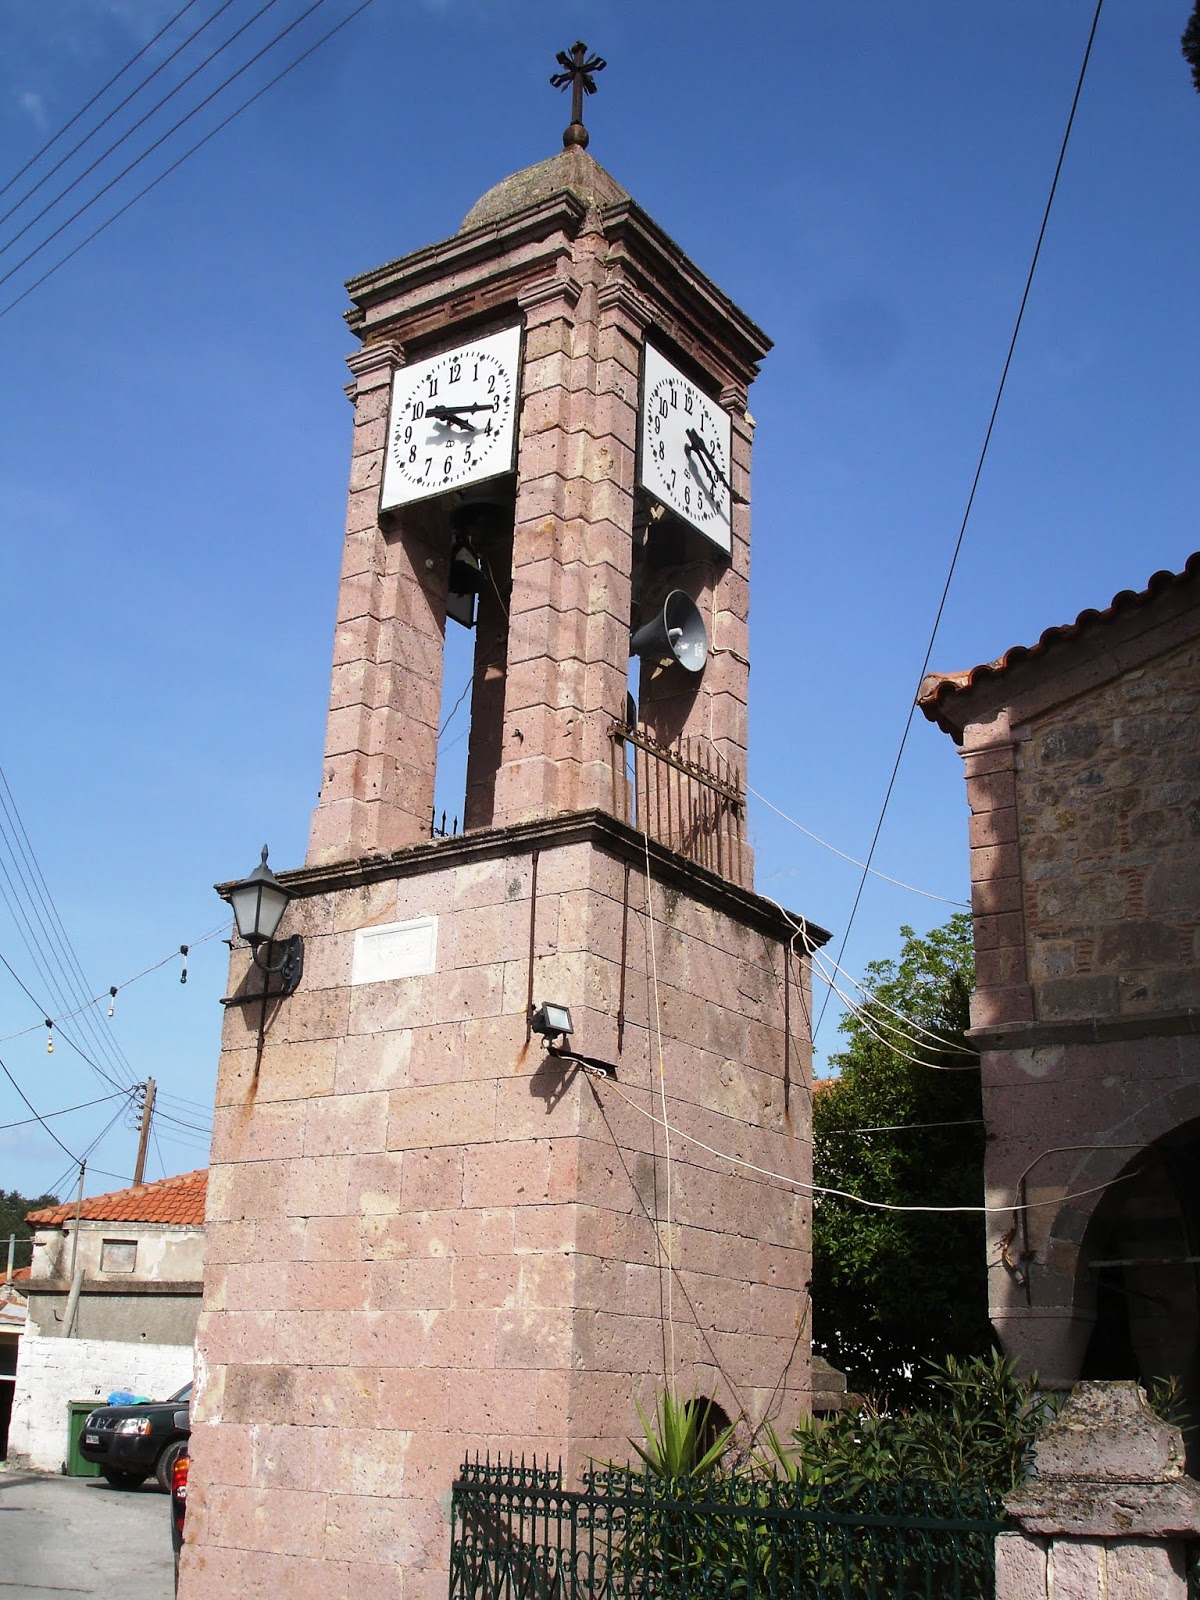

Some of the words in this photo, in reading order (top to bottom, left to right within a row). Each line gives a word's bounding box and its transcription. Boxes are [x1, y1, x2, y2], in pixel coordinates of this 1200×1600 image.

[448, 363, 461, 385] 12
[472, 362, 479, 382] 1
[428, 377, 439, 399] 11
[487, 374, 496, 395] 2
[492, 394, 500, 414] 3
[658, 396, 669, 419] 10
[670, 388, 678, 410] 11
[684, 393, 693, 416] 12
[411, 401, 425, 422] 10
[483, 418, 493, 438] 4
[654, 415, 661, 435] 9
[700, 413, 705, 433] 1
[404, 425, 413, 444] 9
[408, 444, 417, 463] 8
[463, 443, 472, 464] 5
[659, 440, 665, 460] 8
[709, 440, 716, 459] 2
[425, 457, 433, 477] 7
[443, 456, 452, 475] 6
[670, 468, 677, 489] 7
[684, 485, 691, 505] 6
[697, 490, 703, 510] 5
